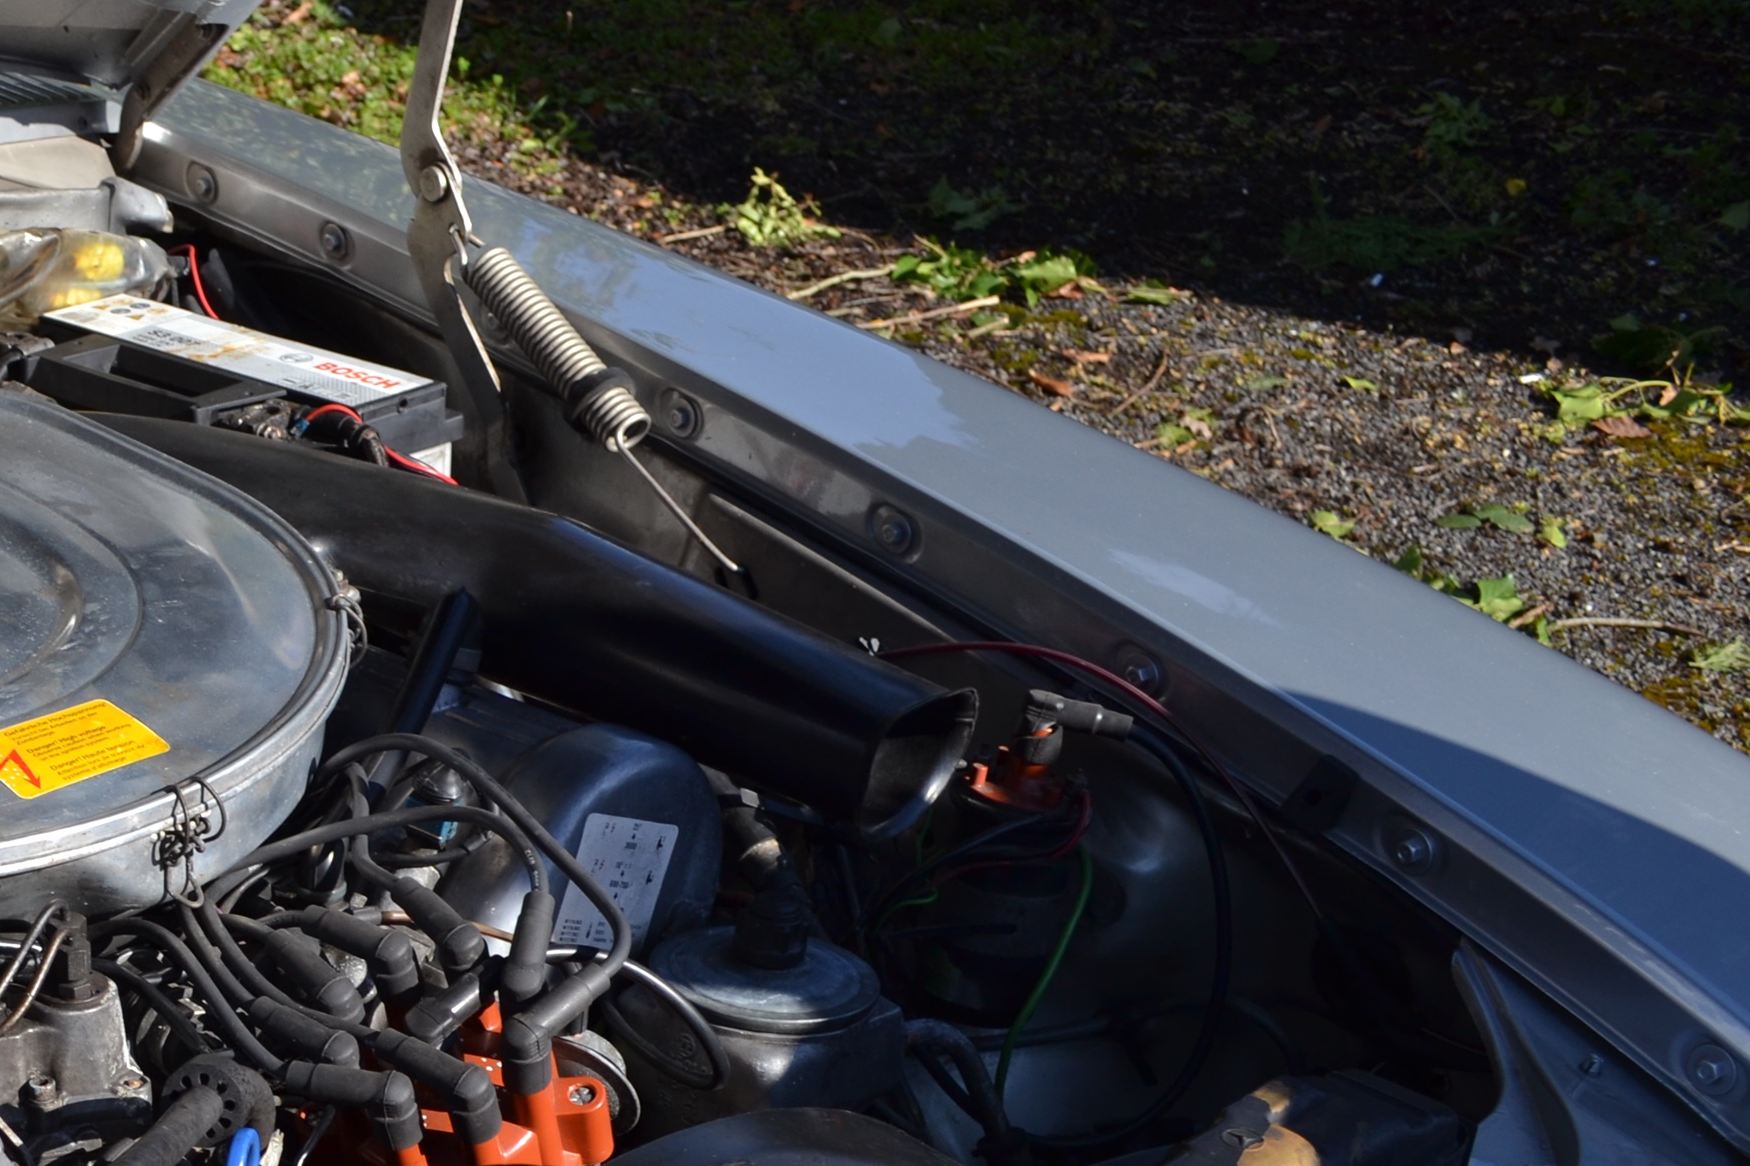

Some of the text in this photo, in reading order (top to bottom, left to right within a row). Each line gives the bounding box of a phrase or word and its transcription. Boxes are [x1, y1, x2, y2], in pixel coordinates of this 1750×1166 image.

[315, 361, 401, 390] BOSCH
[25, 740, 58, 753] Danger!
[78, 725, 106, 736] voltage
[49, 740, 135, 770] Danger! Haute tension
